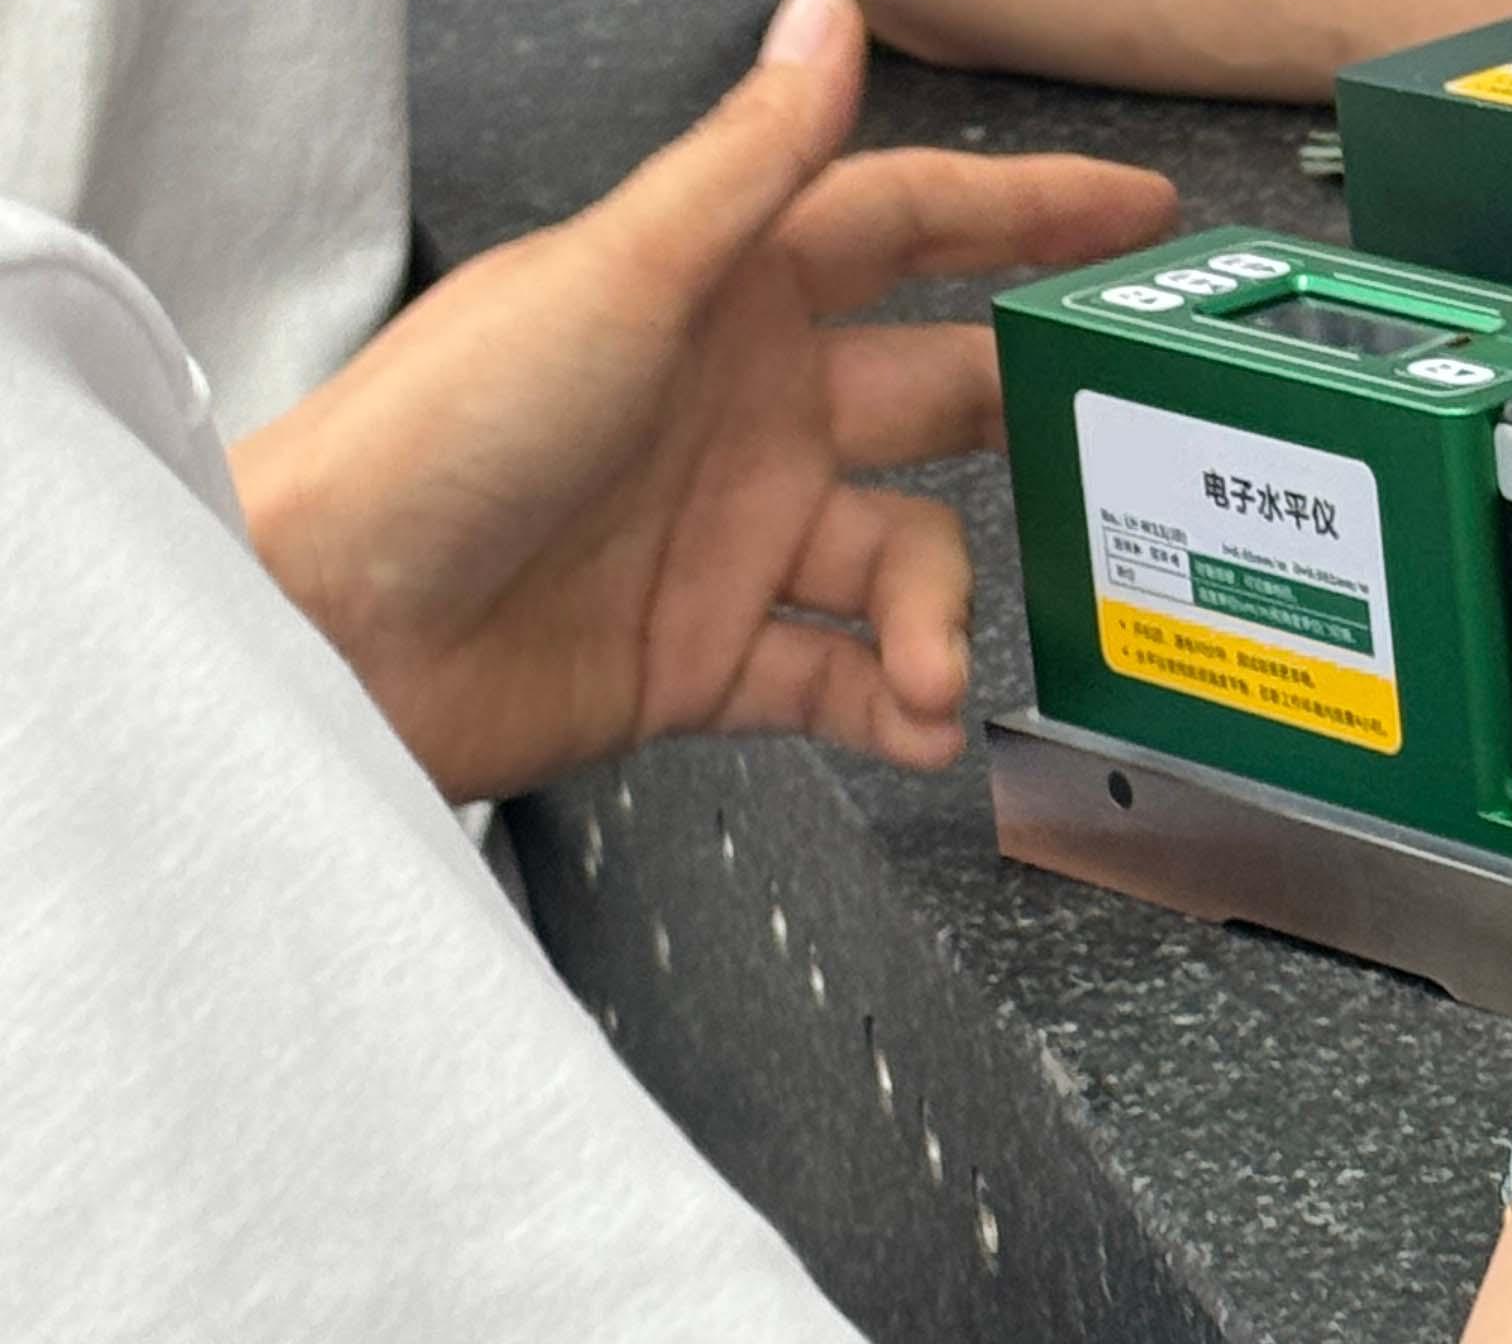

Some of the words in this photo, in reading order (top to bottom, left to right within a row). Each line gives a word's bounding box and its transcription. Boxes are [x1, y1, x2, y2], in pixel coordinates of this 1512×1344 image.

[1202, 468, 1340, 540] 电子水平仪
